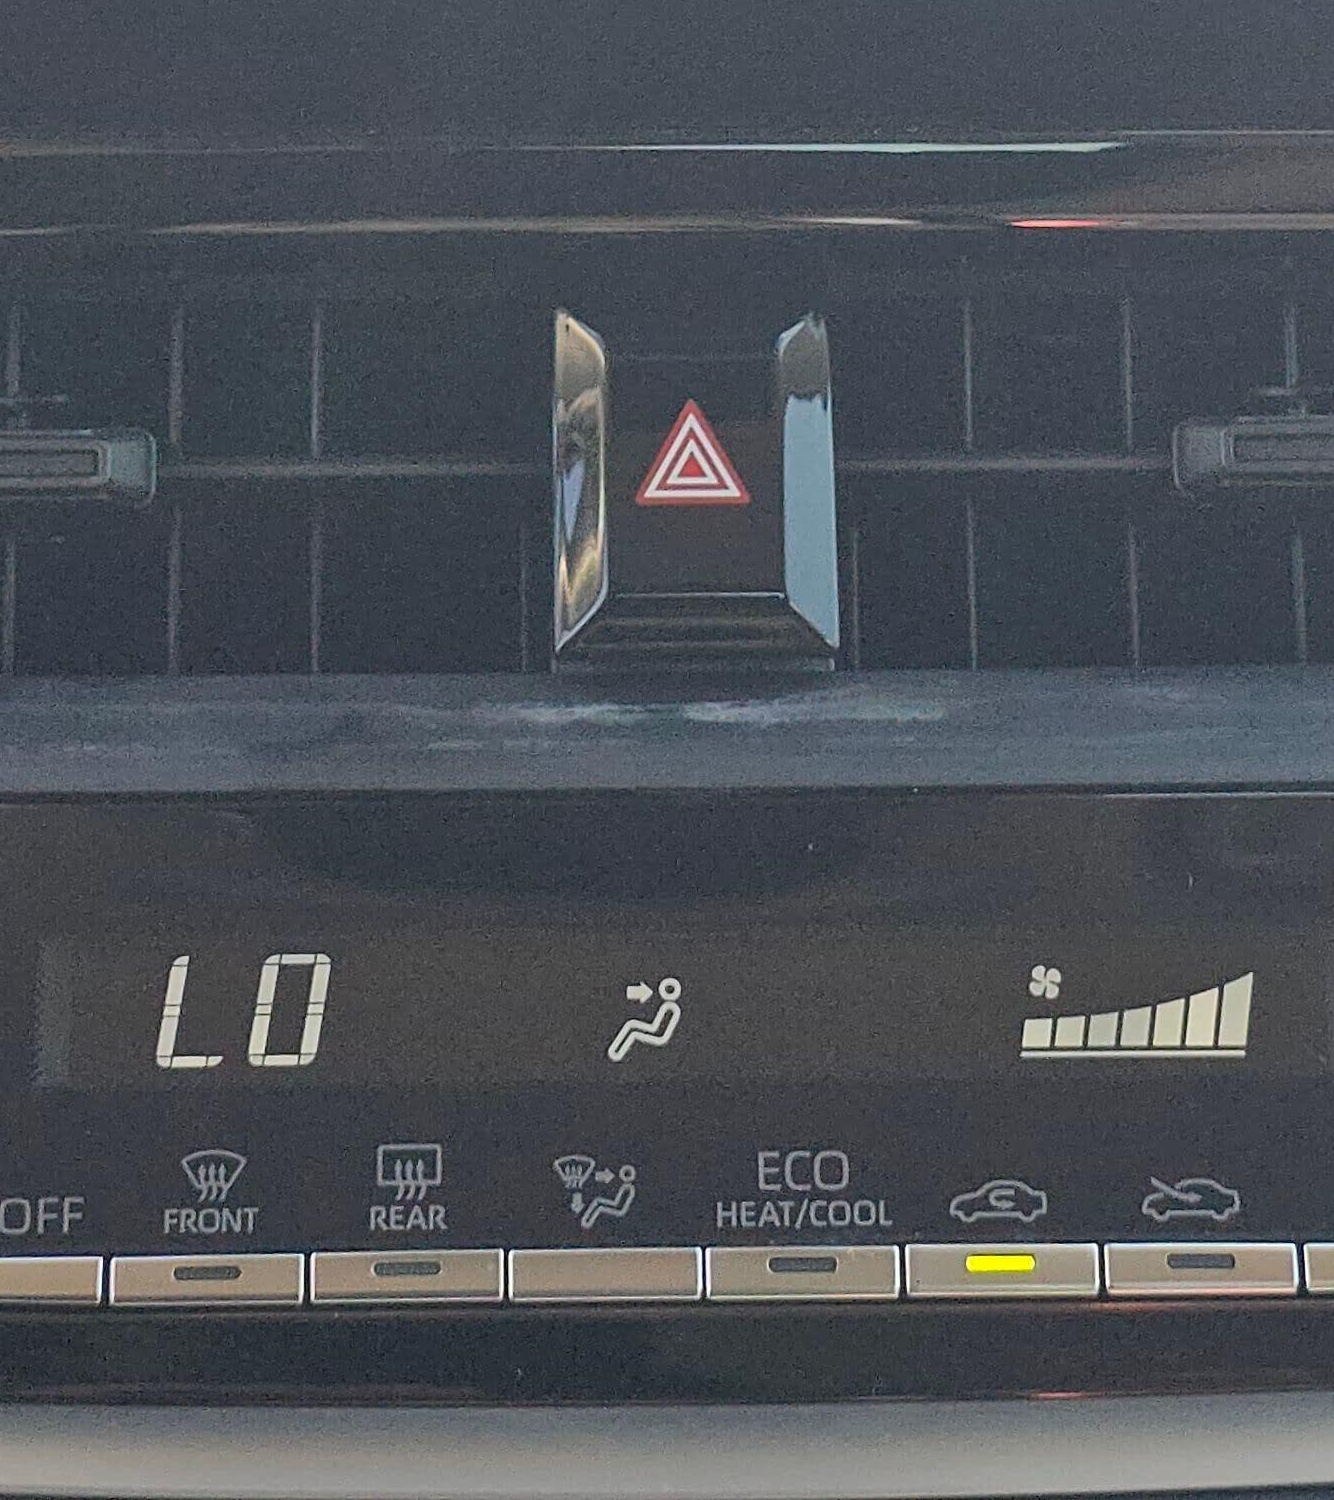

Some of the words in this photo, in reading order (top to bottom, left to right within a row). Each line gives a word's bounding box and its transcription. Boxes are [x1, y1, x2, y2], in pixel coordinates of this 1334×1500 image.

[155, 953, 331, 1069] LO
[757, 1150, 850, 1192] ECO
[164, 1207, 259, 1234] FRONT
[369, 1204, 447, 1231] REAR
[716, 1198, 893, 1230] HEAT/COOL
